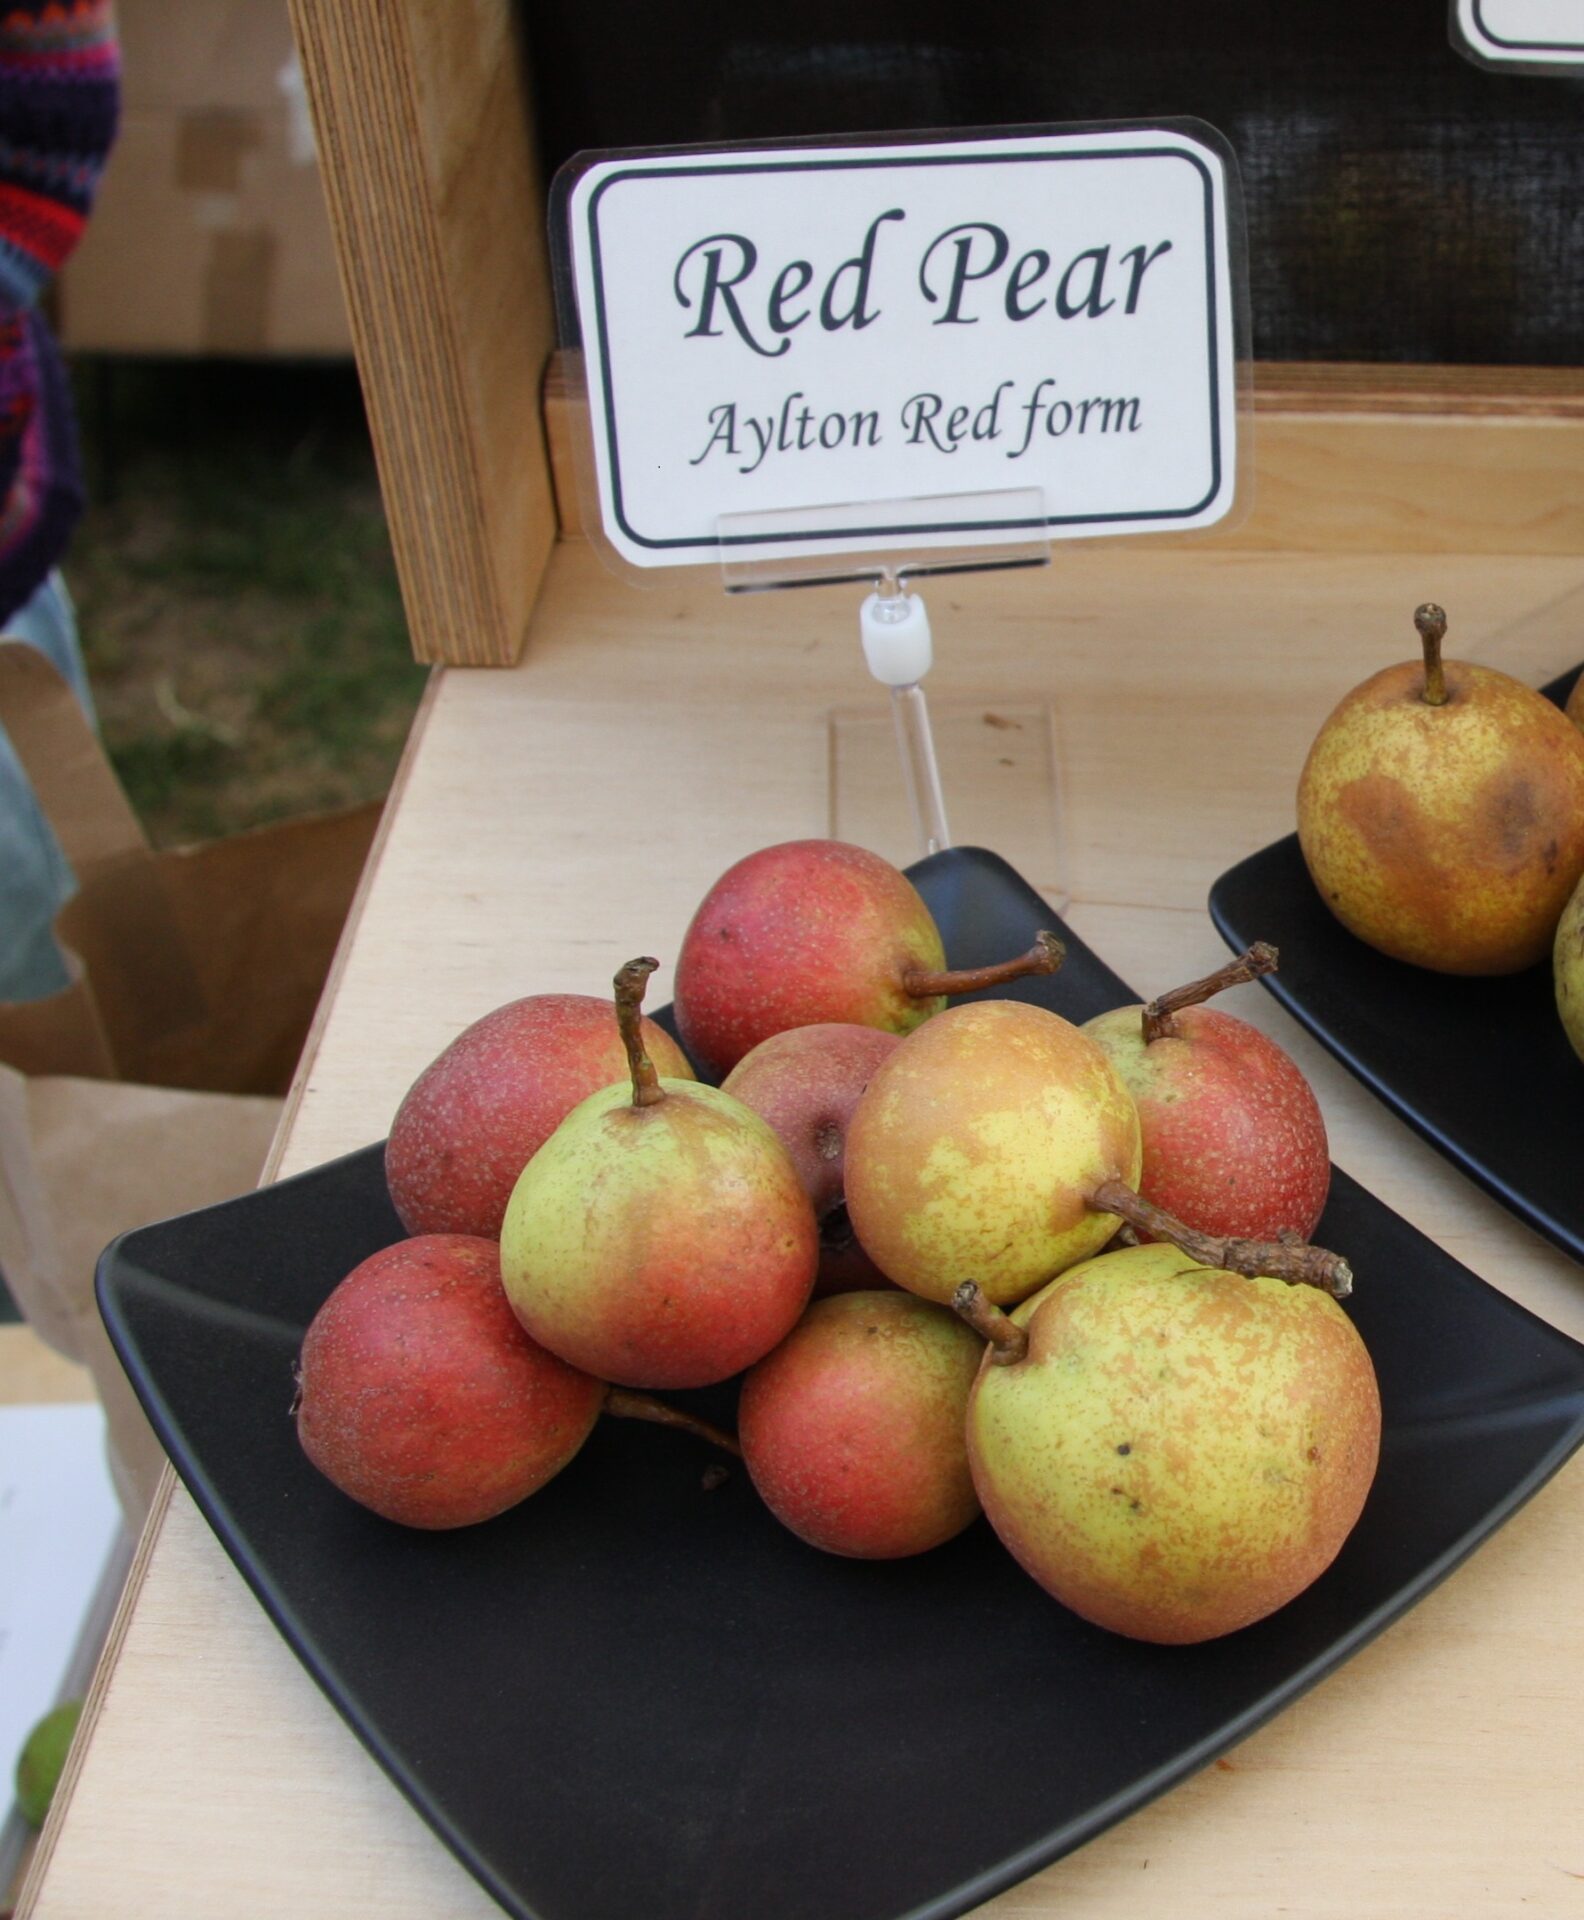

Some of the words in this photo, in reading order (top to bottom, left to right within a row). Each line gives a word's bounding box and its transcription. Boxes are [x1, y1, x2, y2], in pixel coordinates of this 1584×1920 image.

[674, 208, 906, 358] Red
[918, 221, 1173, 325] Pear
[689, 391, 882, 474] Aylton
[900, 379, 1015, 453] Red
[1006, 378, 1142, 459] form
